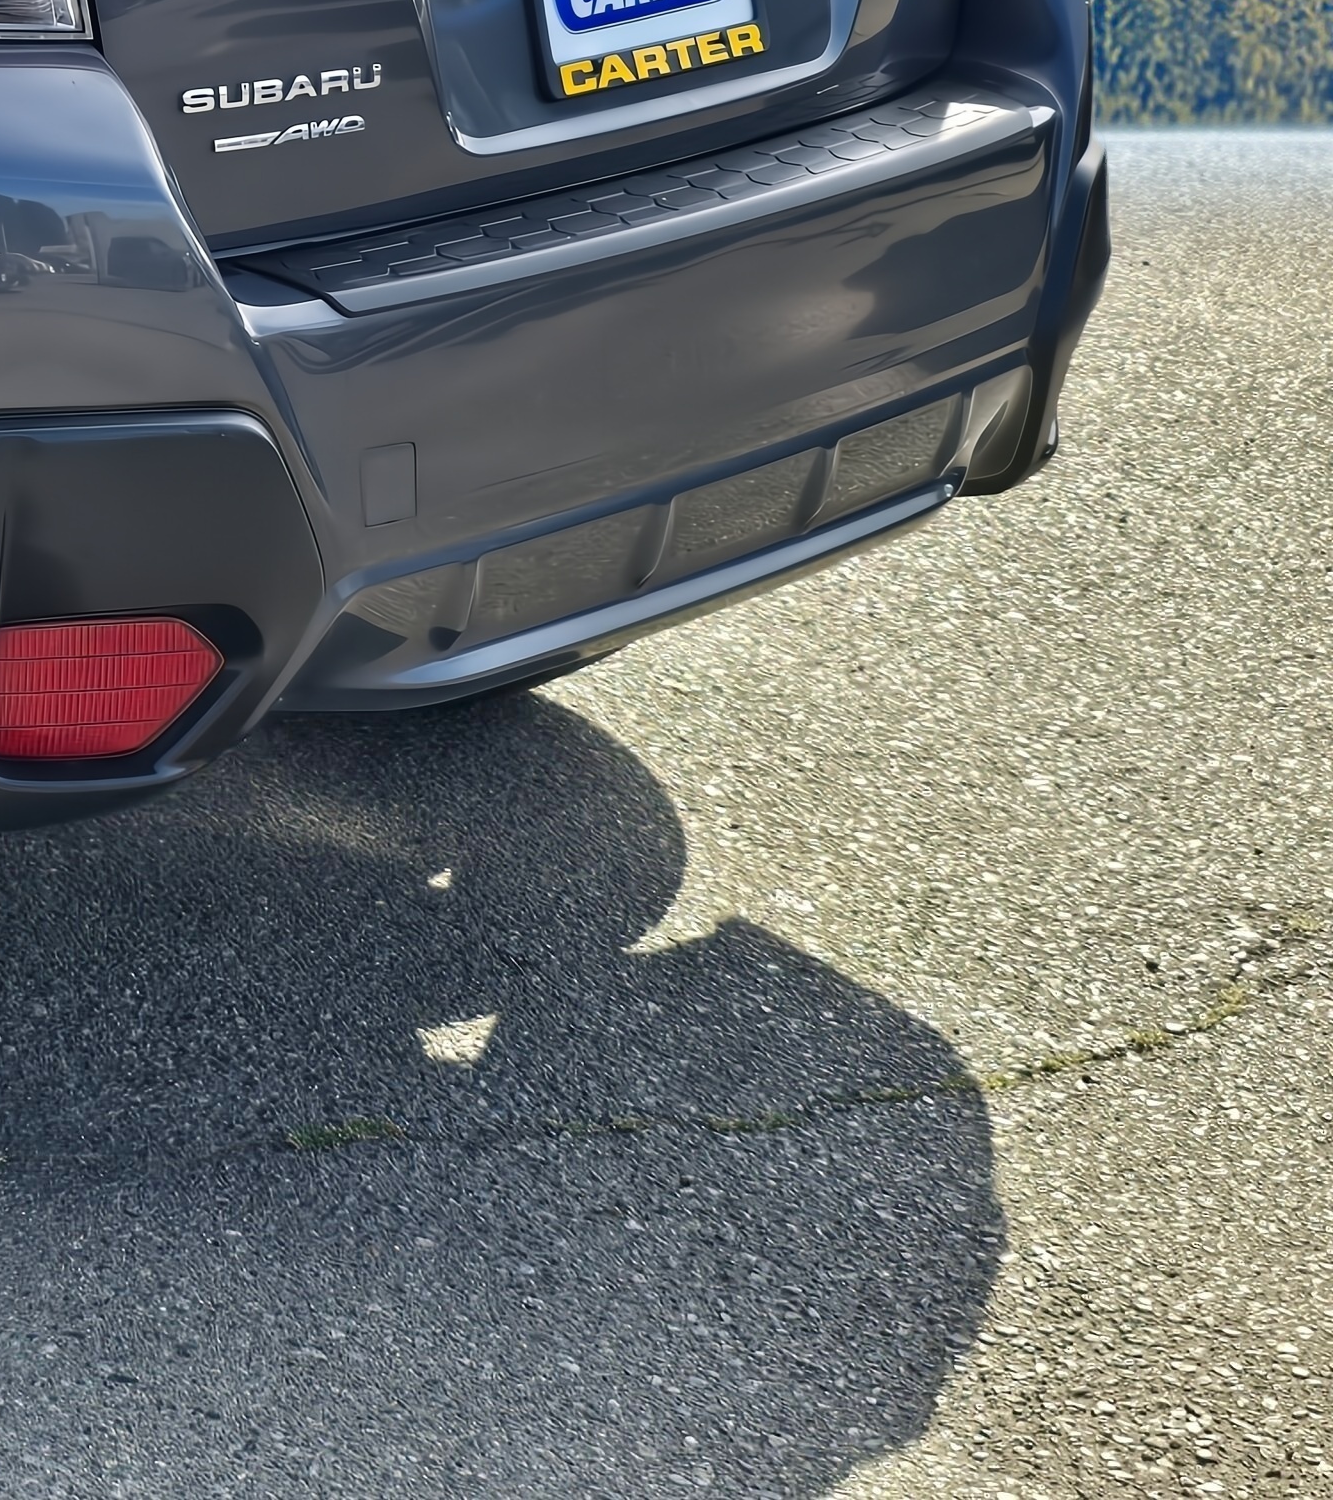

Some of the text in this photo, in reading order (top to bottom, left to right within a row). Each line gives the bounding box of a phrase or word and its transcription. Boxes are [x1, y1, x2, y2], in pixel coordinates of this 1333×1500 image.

[558, 23, 764, 97] CARTER
[182, 63, 382, 114] SUBARU
[273, 115, 366, 145] AWD
